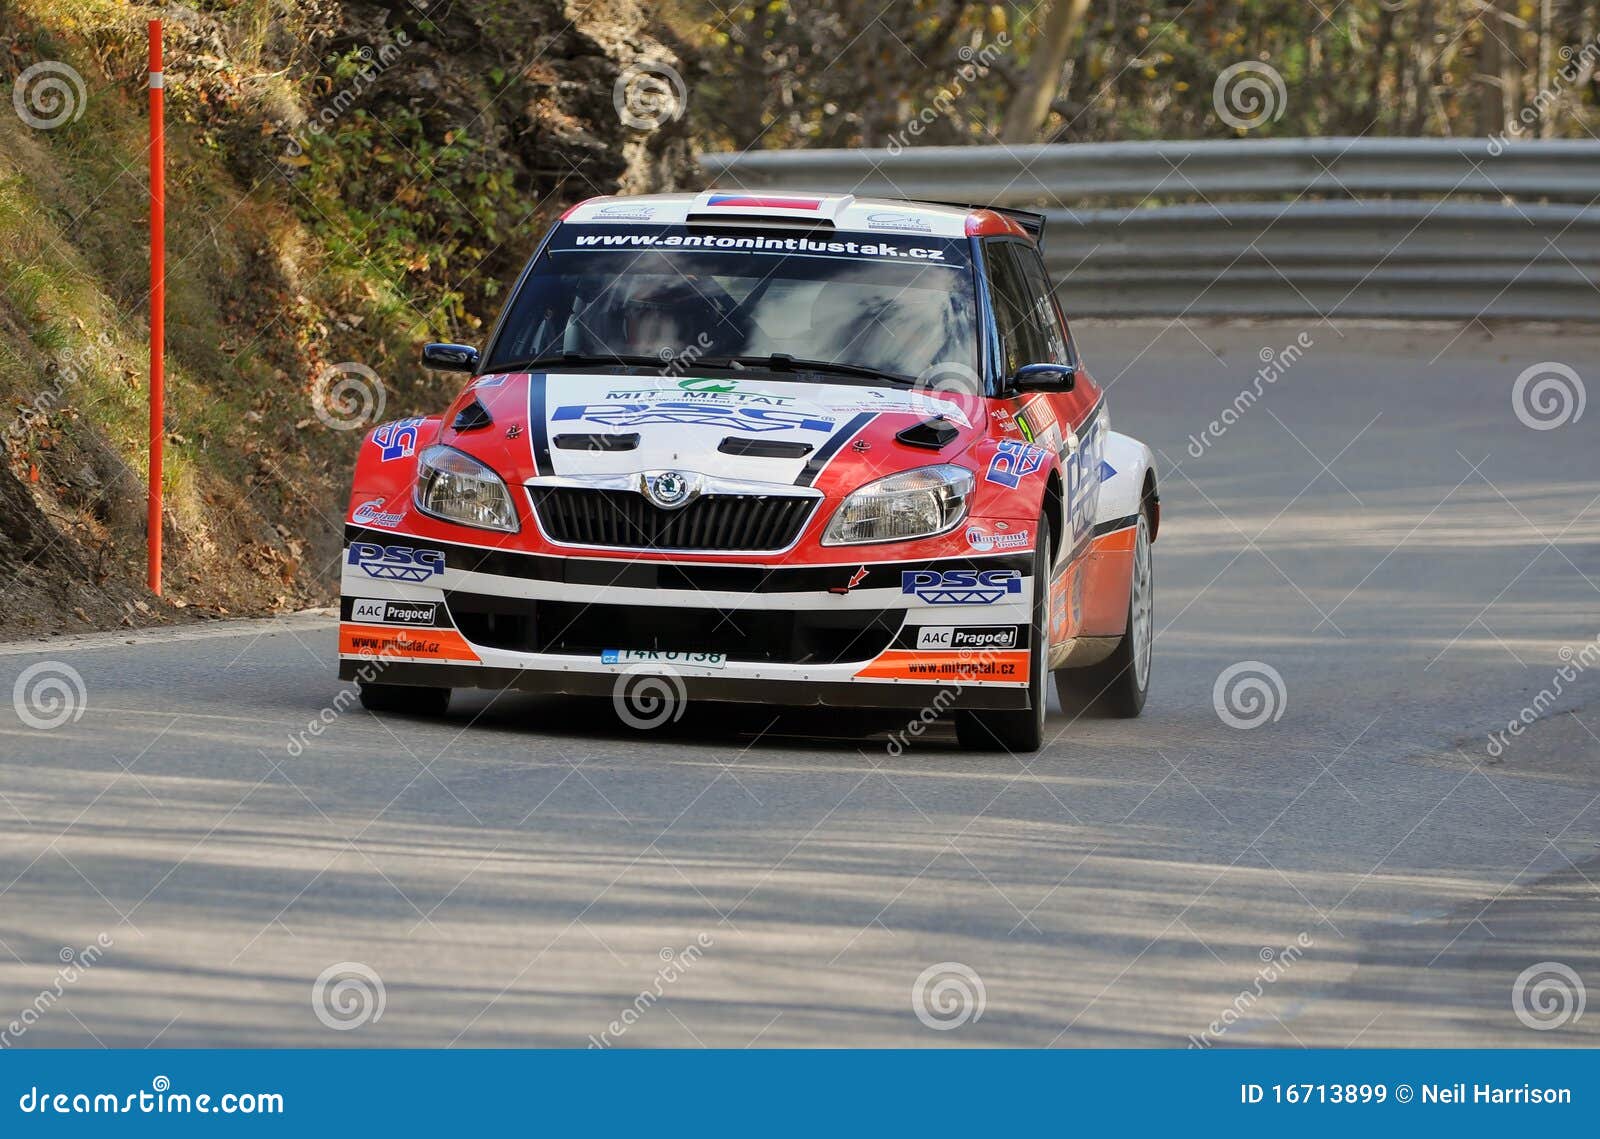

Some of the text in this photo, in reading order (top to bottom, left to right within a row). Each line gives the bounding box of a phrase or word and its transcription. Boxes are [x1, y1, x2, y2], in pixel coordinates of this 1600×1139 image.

[575, 233, 945, 261] www.antonintlustak.cz
[605, 391, 794, 407] MIT METAL
[357, 605, 433, 621] AAC Pragocel
[352, 637, 440, 653] www.mitmetal.cz
[922, 631, 1014, 645] AAC Pragocel
[908, 662, 1015, 674] www.mitmetal.cz
